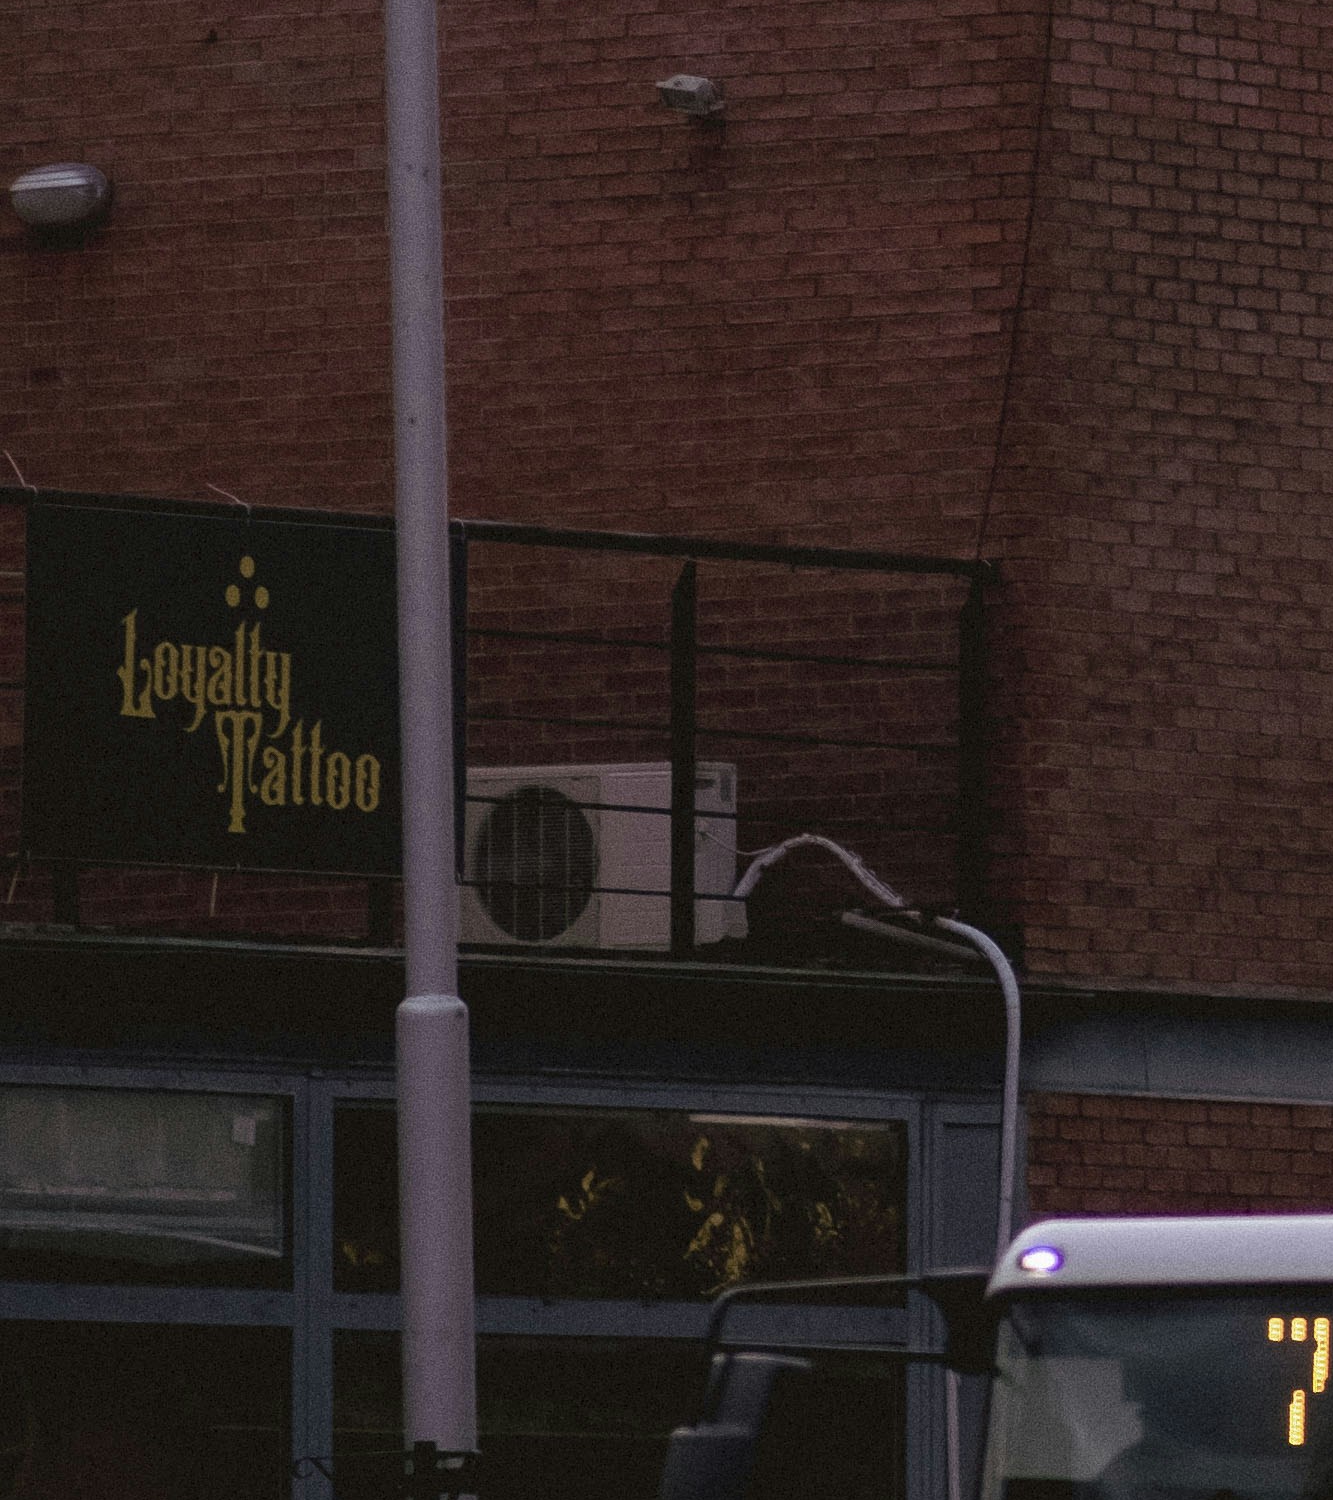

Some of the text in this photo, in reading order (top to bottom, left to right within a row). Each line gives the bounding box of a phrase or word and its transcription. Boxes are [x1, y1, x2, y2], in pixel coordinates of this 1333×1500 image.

[116, 607, 293, 739] Loyalty
[214, 710, 382, 834] Tattoo
[1267, 1316, 1331, 1446] 7
